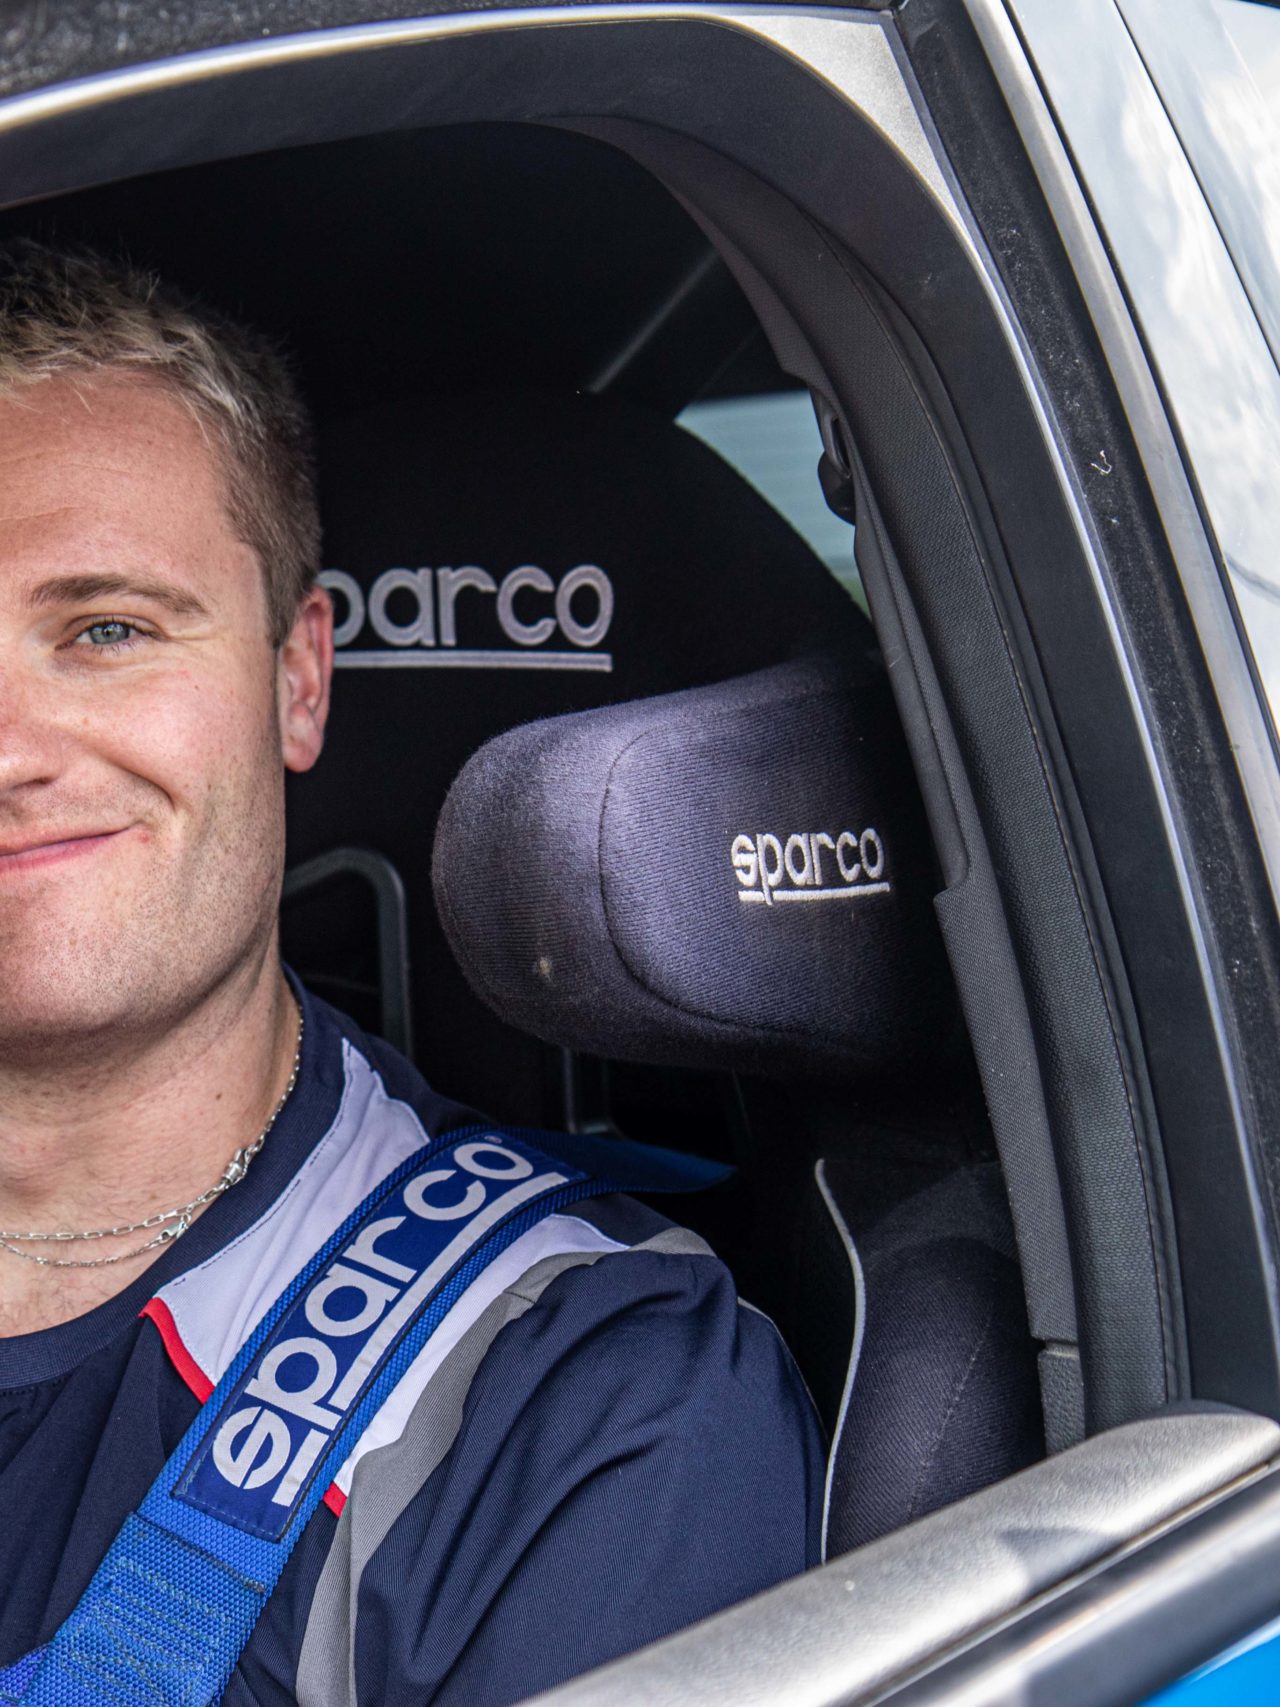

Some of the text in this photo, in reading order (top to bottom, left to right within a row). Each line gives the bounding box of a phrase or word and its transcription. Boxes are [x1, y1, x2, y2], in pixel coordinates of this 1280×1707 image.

[318, 565, 614, 647] parco
[731, 828, 884, 904] sparco
[212, 1142, 534, 1490] sparco
